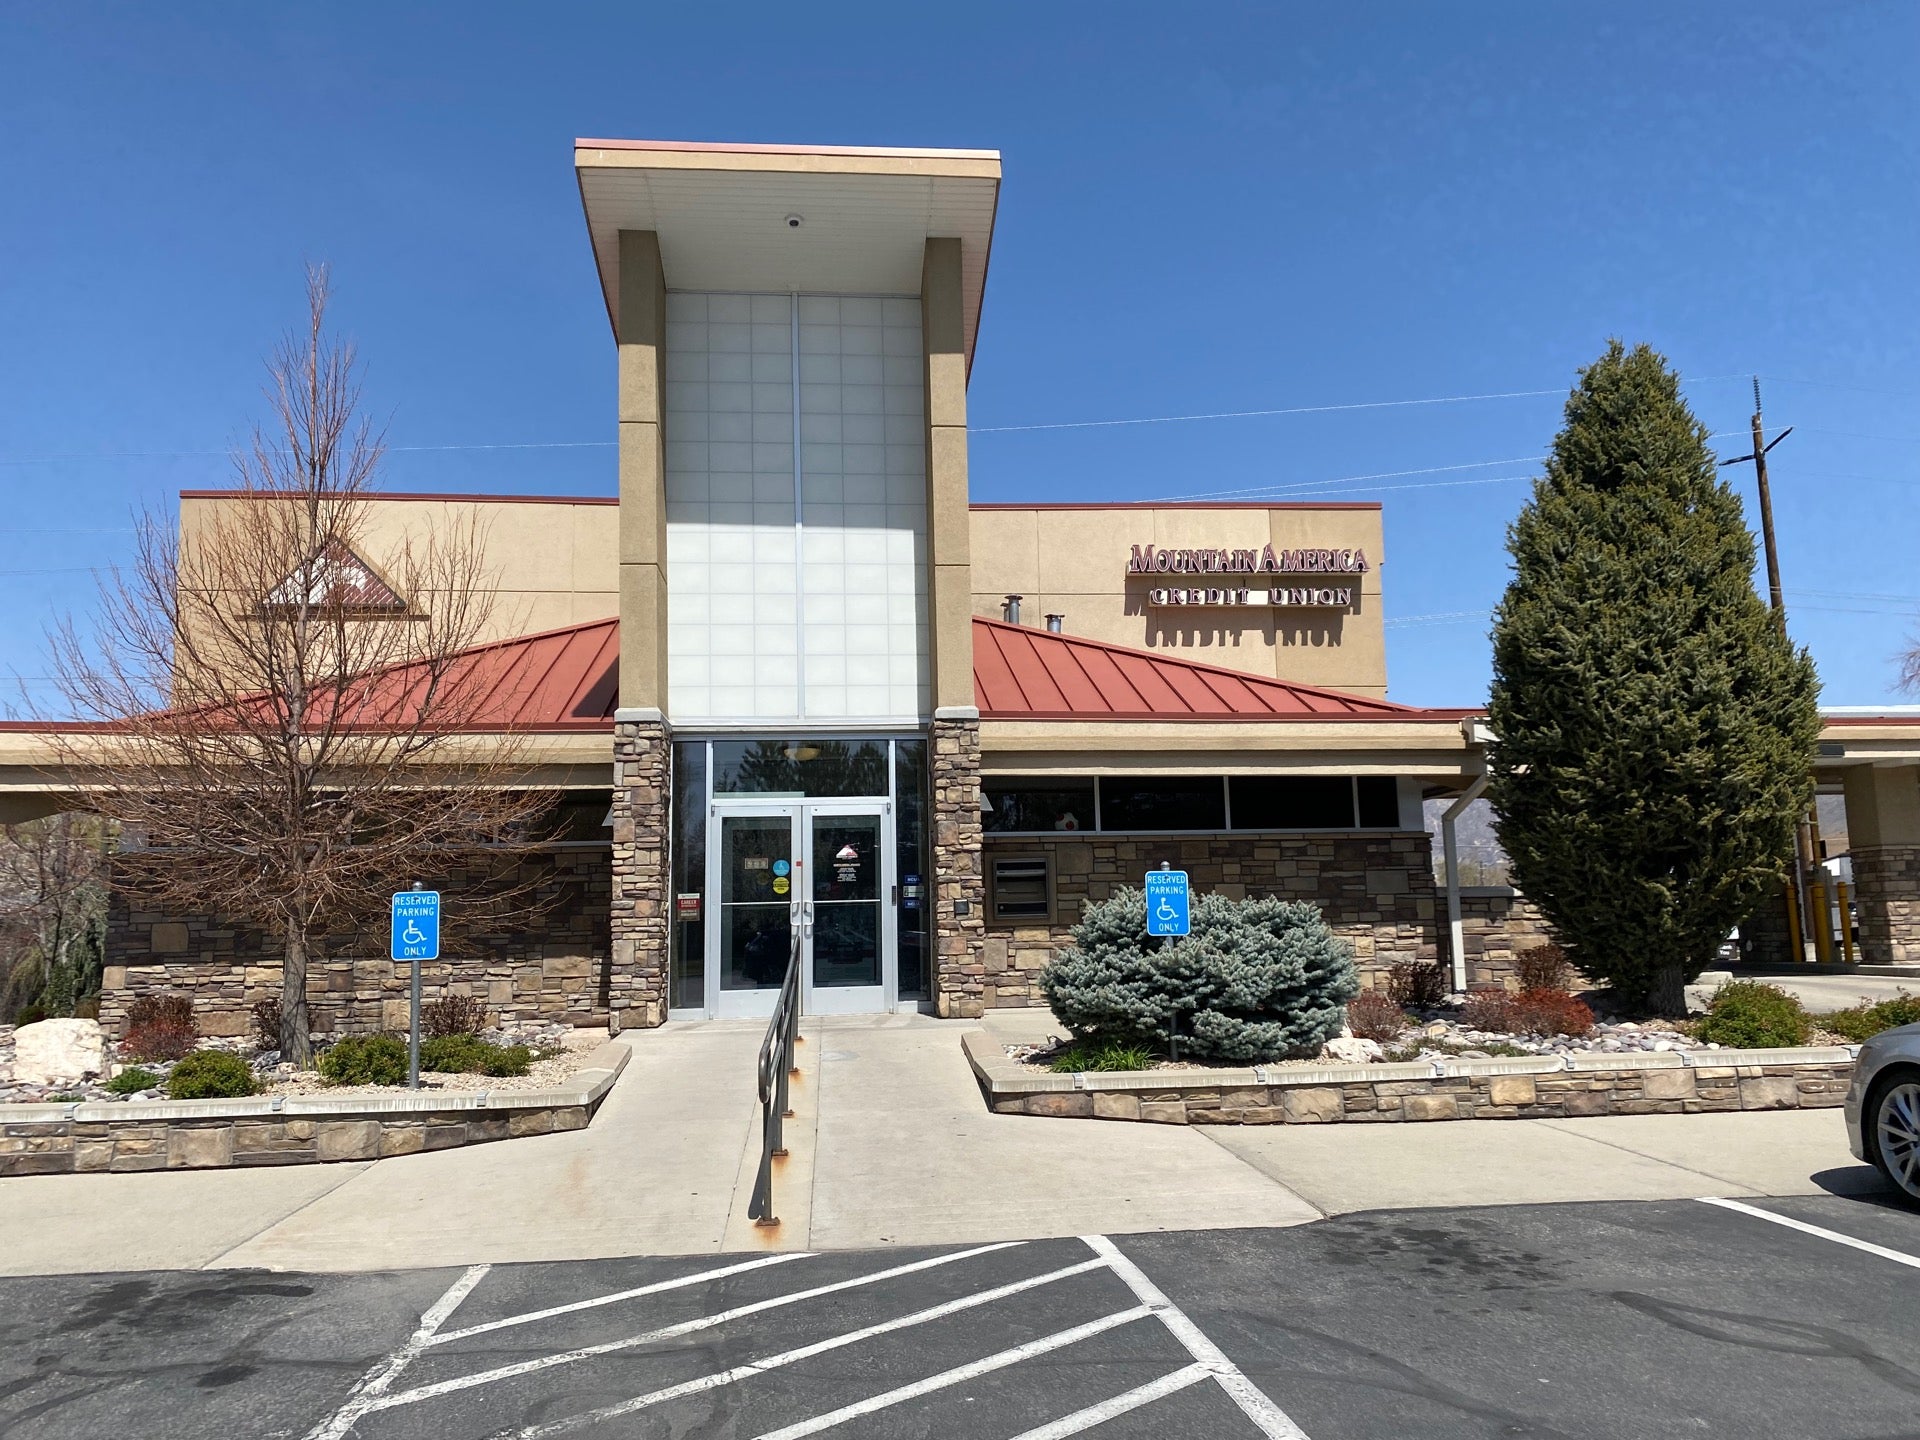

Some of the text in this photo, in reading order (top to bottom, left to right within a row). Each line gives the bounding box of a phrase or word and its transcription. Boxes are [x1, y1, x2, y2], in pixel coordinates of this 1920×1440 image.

[1130, 542, 1371, 573] MOUNTAIN AMERICA
[1151, 587, 1352, 605] CREDIT UNION
[1147, 876, 1186, 884] RESERVED
[1150, 886, 1184, 894] PARKING
[394, 896, 437, 905] RESERVED
[397, 908, 434, 916] PARKING
[1158, 923, 1179, 932] ONLY
[404, 947, 426, 955] ONLY
